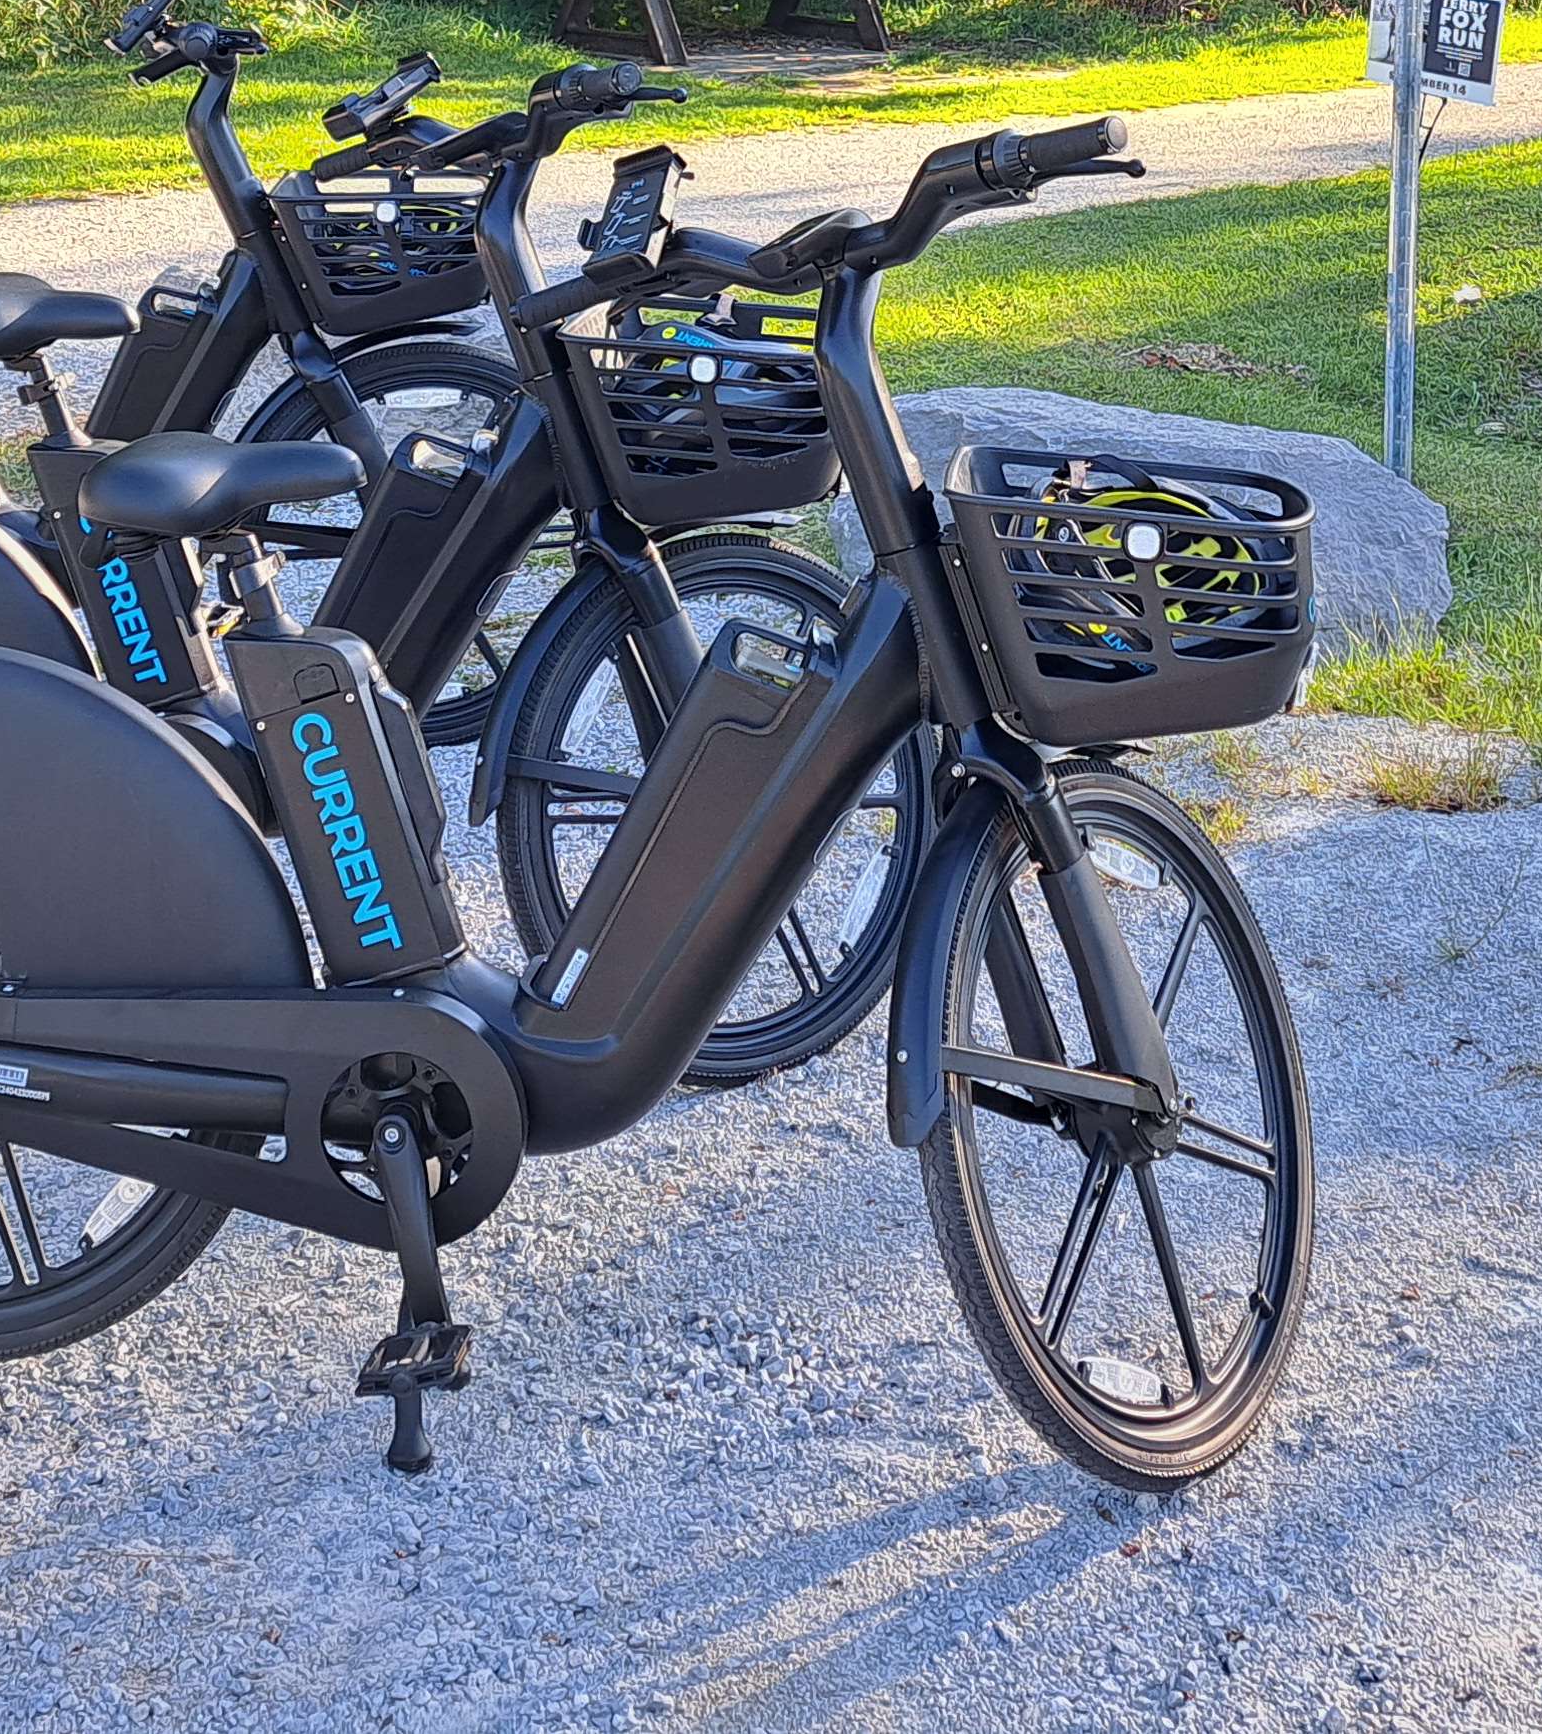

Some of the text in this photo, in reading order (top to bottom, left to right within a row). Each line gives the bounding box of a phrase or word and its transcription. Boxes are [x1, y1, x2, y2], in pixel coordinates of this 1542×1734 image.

[1439, 7, 1488, 33] FOX
[1438, 25, 1485, 50] RUN
[1452, 83, 1467, 96] 14
[79, 515, 168, 684] RRENT
[291, 711, 405, 953] CURRENT
